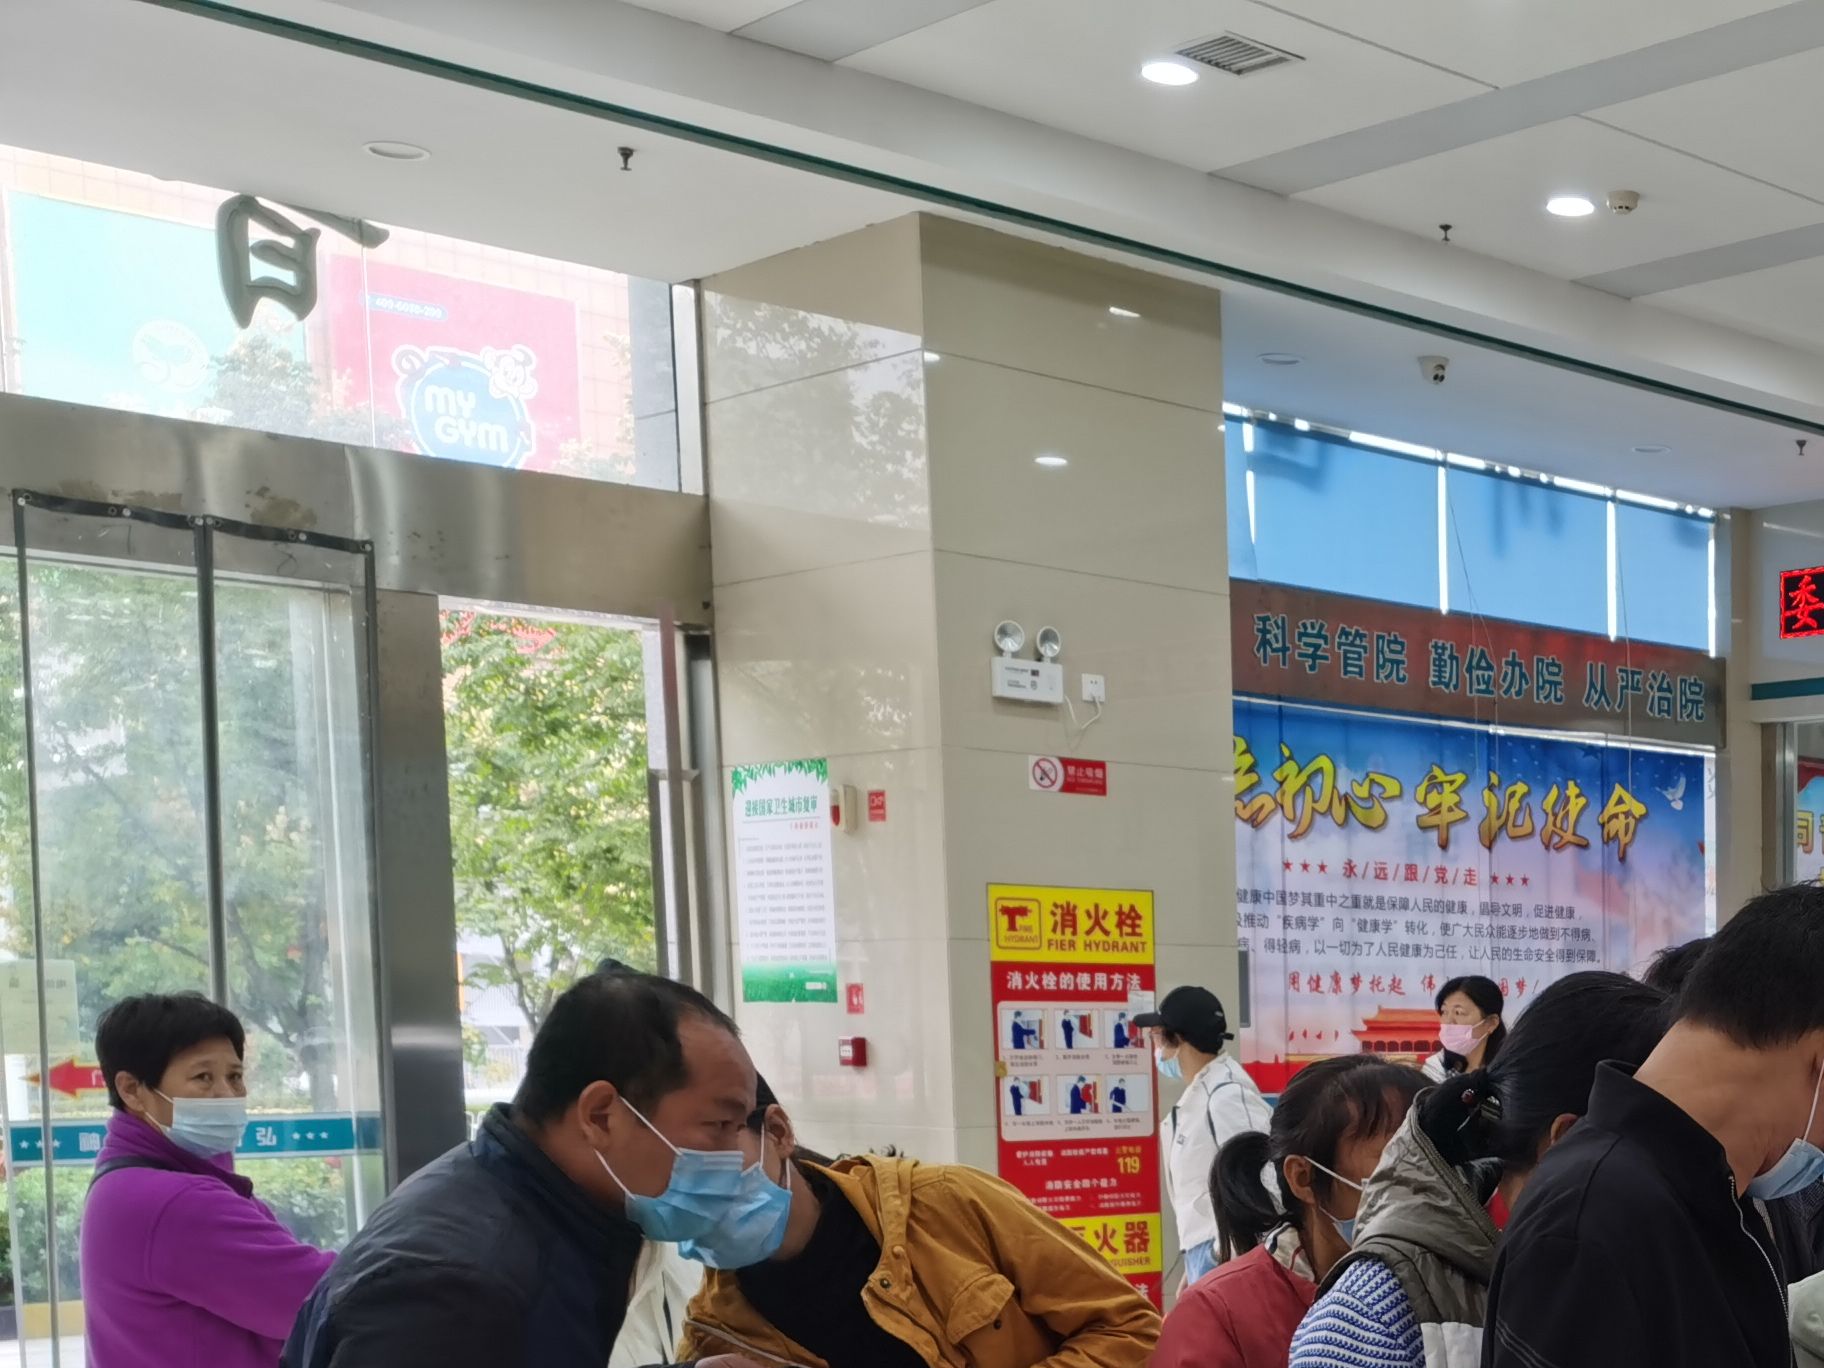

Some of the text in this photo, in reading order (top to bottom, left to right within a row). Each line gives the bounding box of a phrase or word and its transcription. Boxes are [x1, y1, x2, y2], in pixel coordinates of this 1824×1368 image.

[434, 415, 510, 453] GYM
[1253, 612, 1706, 722] 科学管院 勤俭办院 从严治院
[1050, 899, 1143, 938] 消火栓
[1047, 938, 1147, 953] FIER HYDRANT
[1006, 971, 1141, 992] 消火栓的使用方法
[1117, 1156, 1141, 1175] 119
